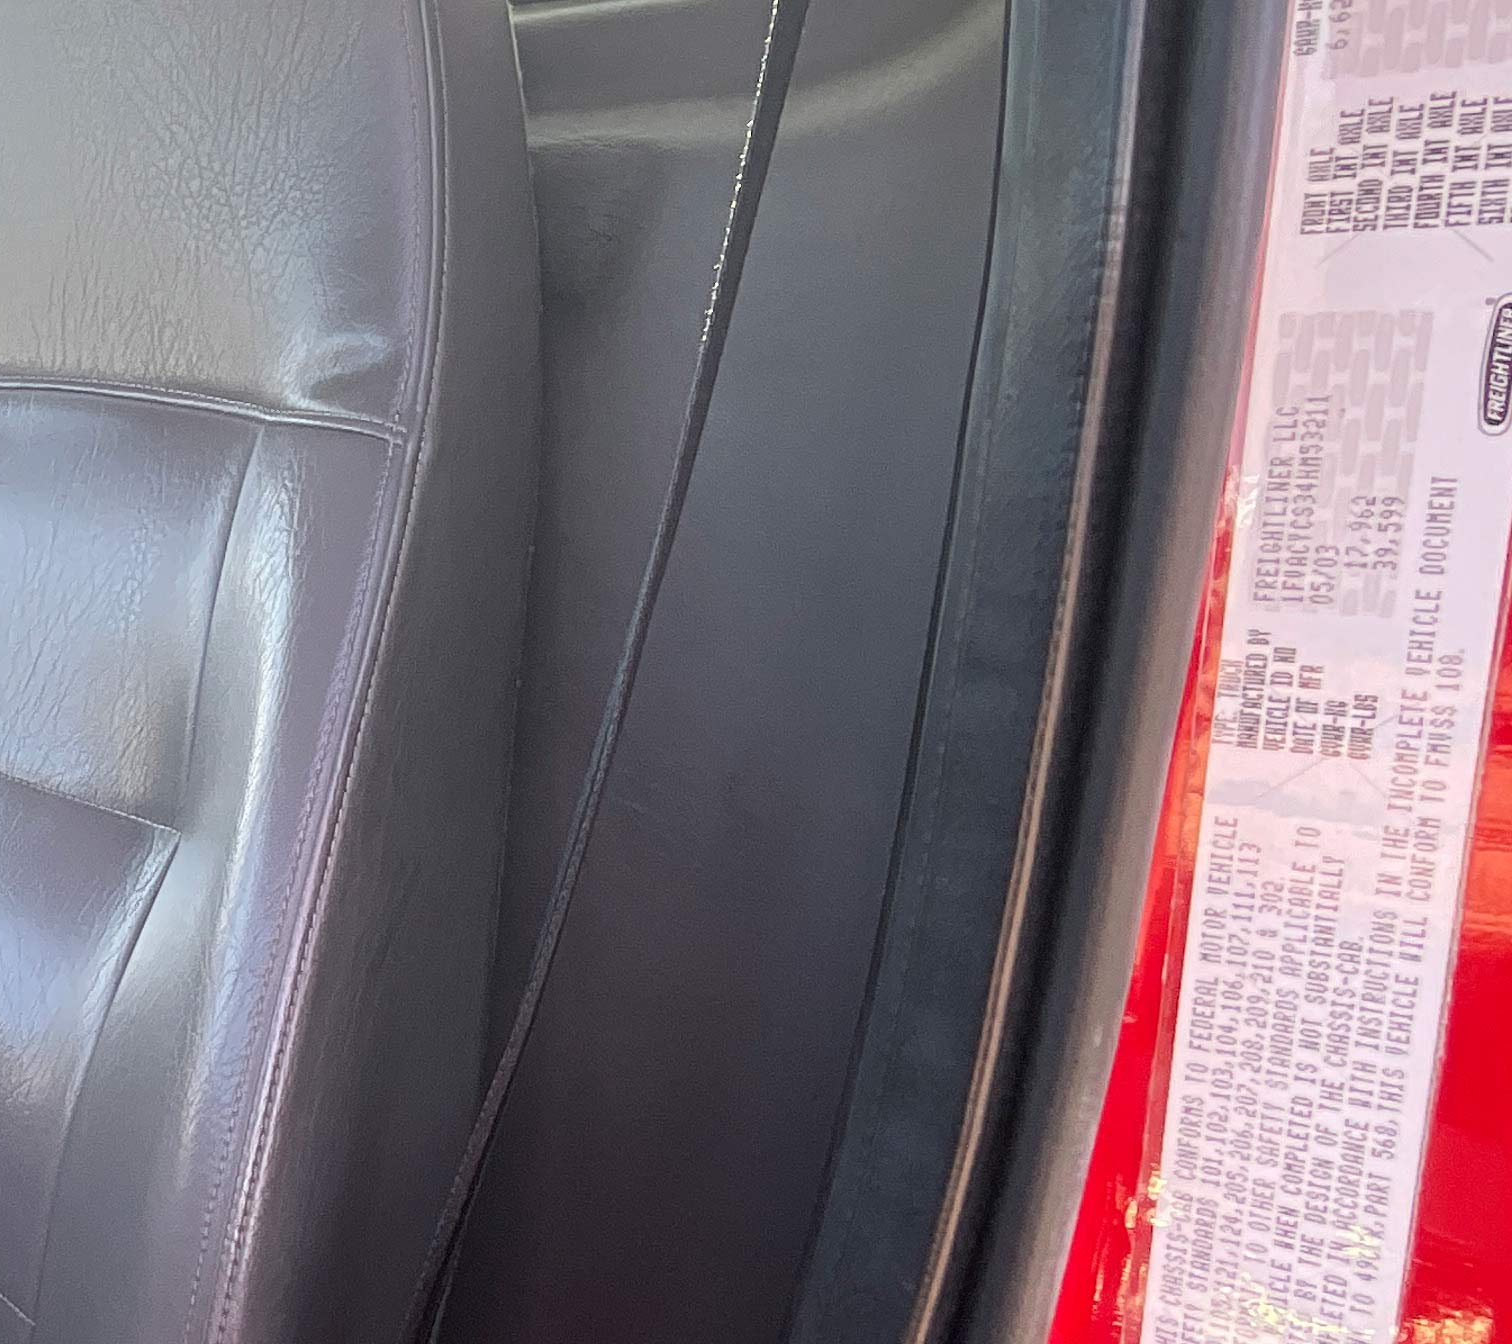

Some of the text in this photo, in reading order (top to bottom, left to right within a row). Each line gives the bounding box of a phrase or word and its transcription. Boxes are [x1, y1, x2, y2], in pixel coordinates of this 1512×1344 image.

[1338, 107, 1365, 145] AXLE
[1366, 96, 1394, 134] AXLE
[1396, 103, 1425, 141] AXLE
[1427, 91, 1458, 130] AXLE
[1458, 97, 1488, 136] AXLE
[1299, 192, 1328, 235] FRONT
[1326, 190, 1355, 233] FIRST
[1353, 178, 1384, 232] SECOND
[1382, 185, 1414, 230] THIRD
[1413, 174, 1446, 229] FOURTH
[1444, 181, 1478, 227] FIFTH
[1477, 178, 1510, 225] SIXTH
[1485, 306, 1512, 420] FREIGHTLINER
[1253, 405, 1300, 602] FREIGHTLINER LLC
[1418, 474, 1459, 576] DOCUMENT
[1342, 494, 1378, 571] 17,962
[1373, 494, 1406, 571] 39,599
[1308, 544, 1341, 606] 05/03
[1404, 589, 1443, 676] VEHICLE
[1236, 628, 1273, 750] MANUFACTURED BY
[1270, 670, 1296, 688] ID
[1261, 695, 1292, 752] VEHICLE
[1296, 696, 1321, 713] OF
[1289, 722, 1319, 754] DATE
[1386, 688, 1429, 812] INCOMPLETE
[1424, 704, 1458, 768] FMVSS
[1420, 779, 1447, 803] TO
[1205, 815, 1239, 896] VEHICLE
[1380, 824, 1411, 860] THE
[1405, 816, 1442, 902] CONFORM
[1375, 872, 1403, 897] IN
[1198, 906, 1228, 963] MOTOR
[1304, 855, 1345, 1005] SUBSTANTIALLY
[1398, 916, 1429, 962] WILL
[1355, 909, 1398, 1051] INSTRUCTIONS
[1188, 976, 1219, 1053] FEDERAL
[1299, 1015, 1323, 1051] NOT
[1386, 973, 1419, 1056] VEHICLE
[1243, 825, 1322, 1264] TO OTHER SAFETY STANDARDS APPLICABLE TO
[1184, 1062, 1209, 1082] TO
[1295, 1062, 1317, 1083] IS
[1318, 1078, 1346, 1111] THE
[1348, 1060, 1378, 1108] WITH
[1174, 1094, 1206, 1180] CONFORMS
[1280, 1094, 1313, 1195] COMPLETED
[1315, 1123, 1339, 1147] OF
[1303, 1156, 1336, 1224] DESIGN
[1333, 1118, 1370, 1231] ACCORDANCE
[1188, 1195, 1221, 1293] STANDARDS
[1273, 1205, 1301, 1250] WHEN
[1298, 1233, 1326, 1266] THE
[1294, 1278, 1318, 1301] BY
[1351, 1292, 1375, 1317] TO
